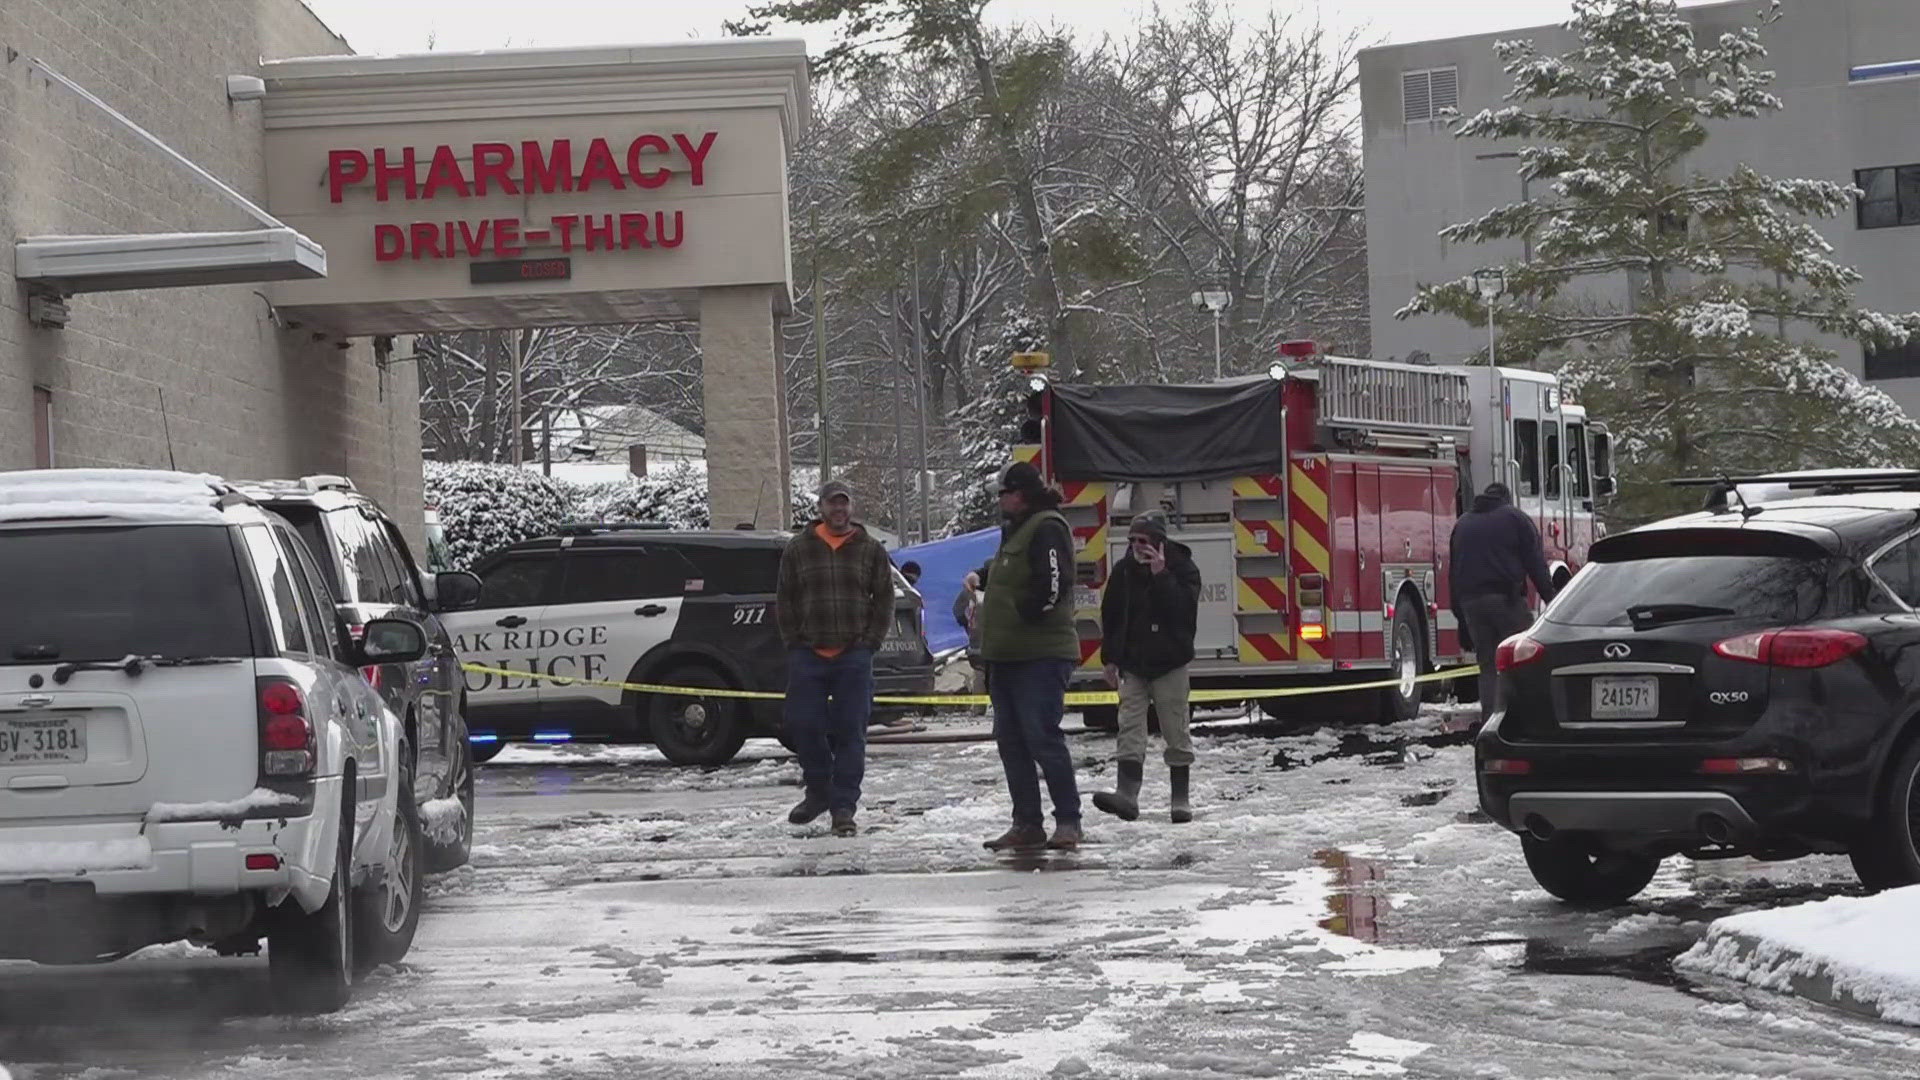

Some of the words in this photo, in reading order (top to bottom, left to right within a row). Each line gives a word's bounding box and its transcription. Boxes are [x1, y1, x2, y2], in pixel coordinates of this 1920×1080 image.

[328, 131, 718, 203] PHARMACY
[374, 210, 684, 262] DRIVE-THRU
[732, 608, 766, 625] 911
[453, 632, 493, 653] AK
[503, 625, 608, 650] RIDGE
[463, 653, 609, 692] OLICE
[1710, 691, 1748, 704] QX50
